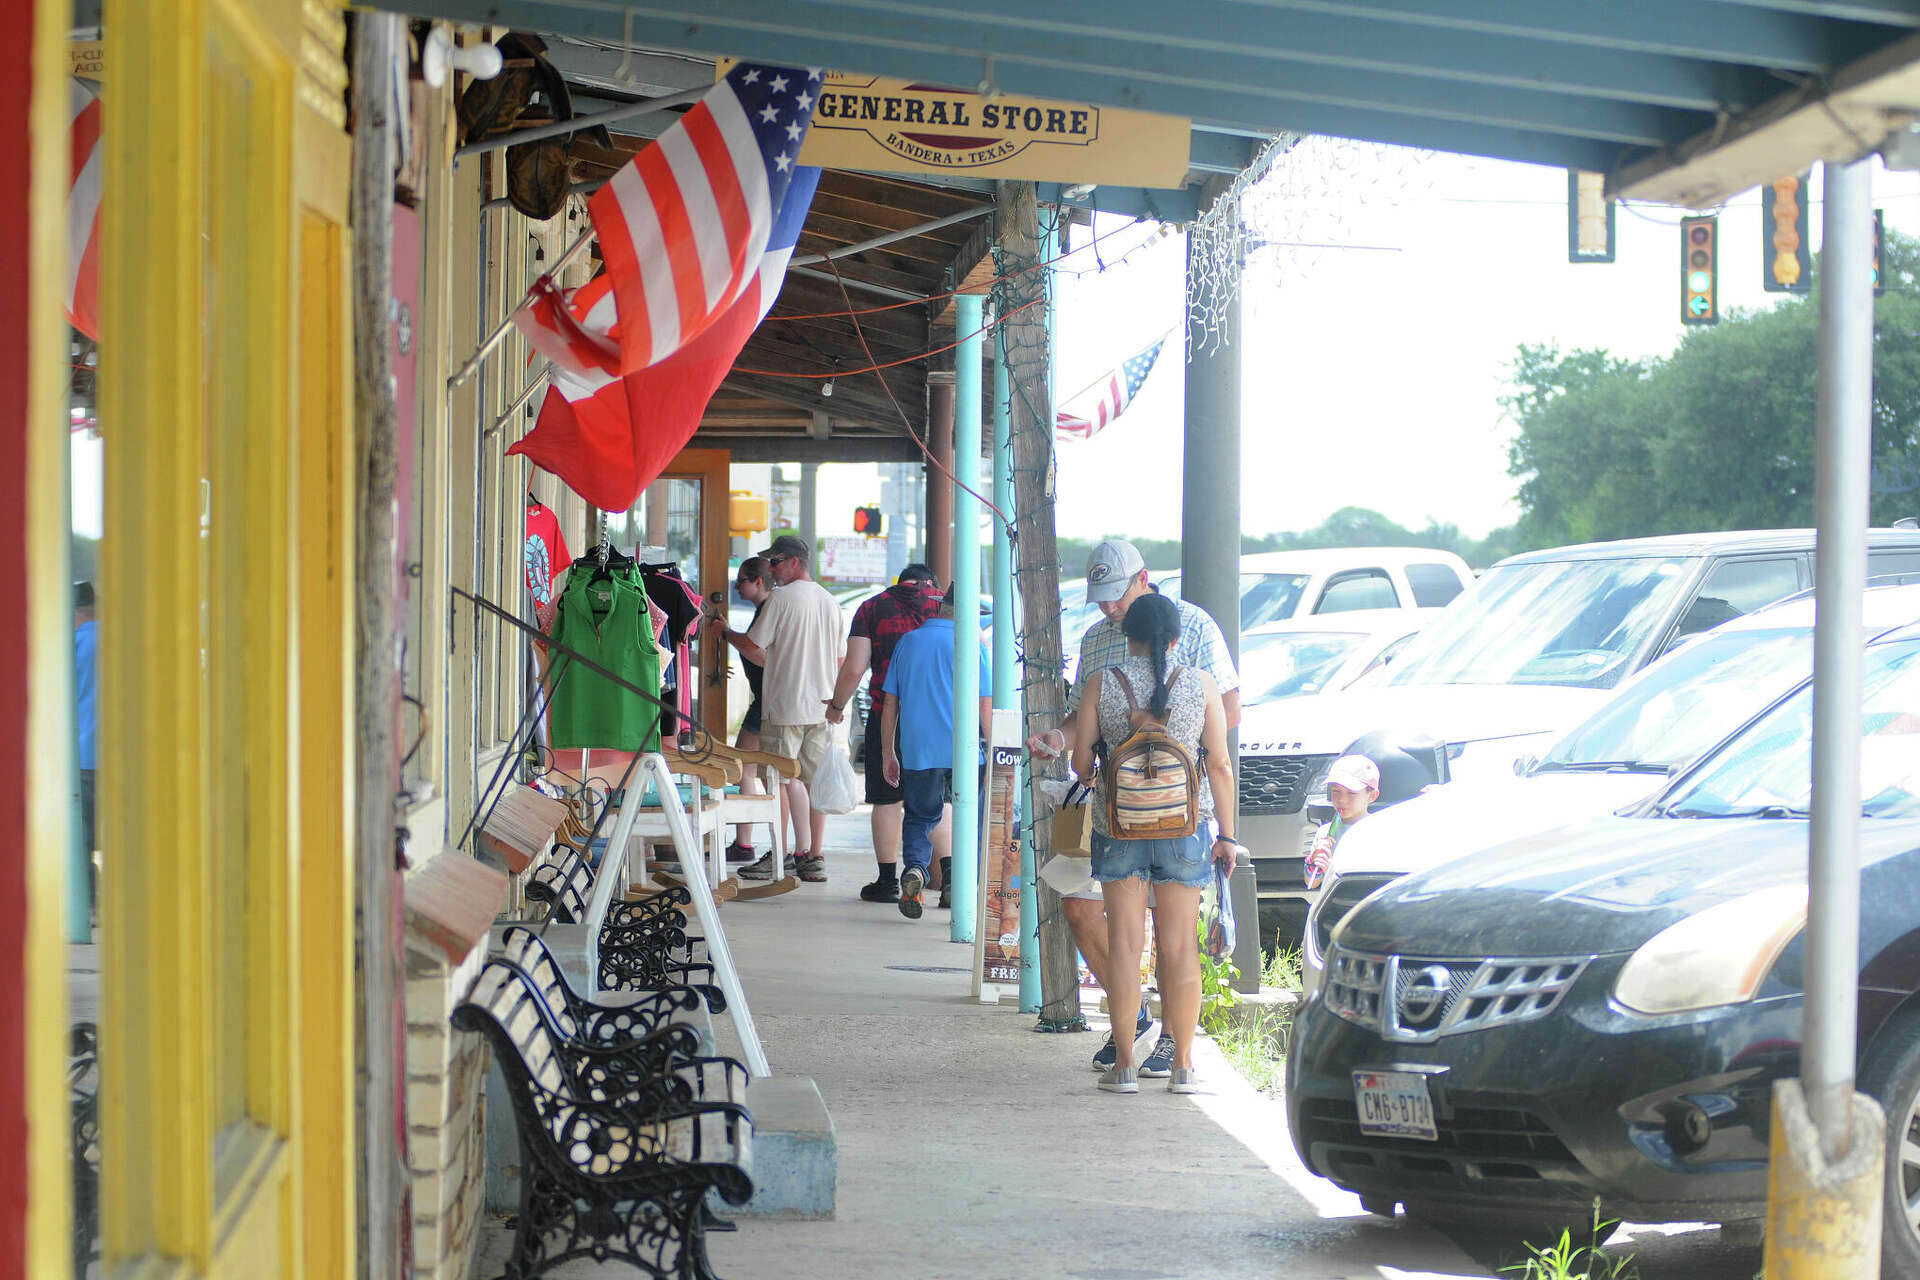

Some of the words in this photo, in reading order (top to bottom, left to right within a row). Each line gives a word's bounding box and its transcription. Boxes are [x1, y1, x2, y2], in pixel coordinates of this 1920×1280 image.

[818, 92, 970, 127] GENERAL
[982, 104, 1089, 135] STORE
[885, 132, 953, 164] BANDERA
[968, 140, 1016, 164] TEXAS
[1239, 742, 1302, 751] ROVER
